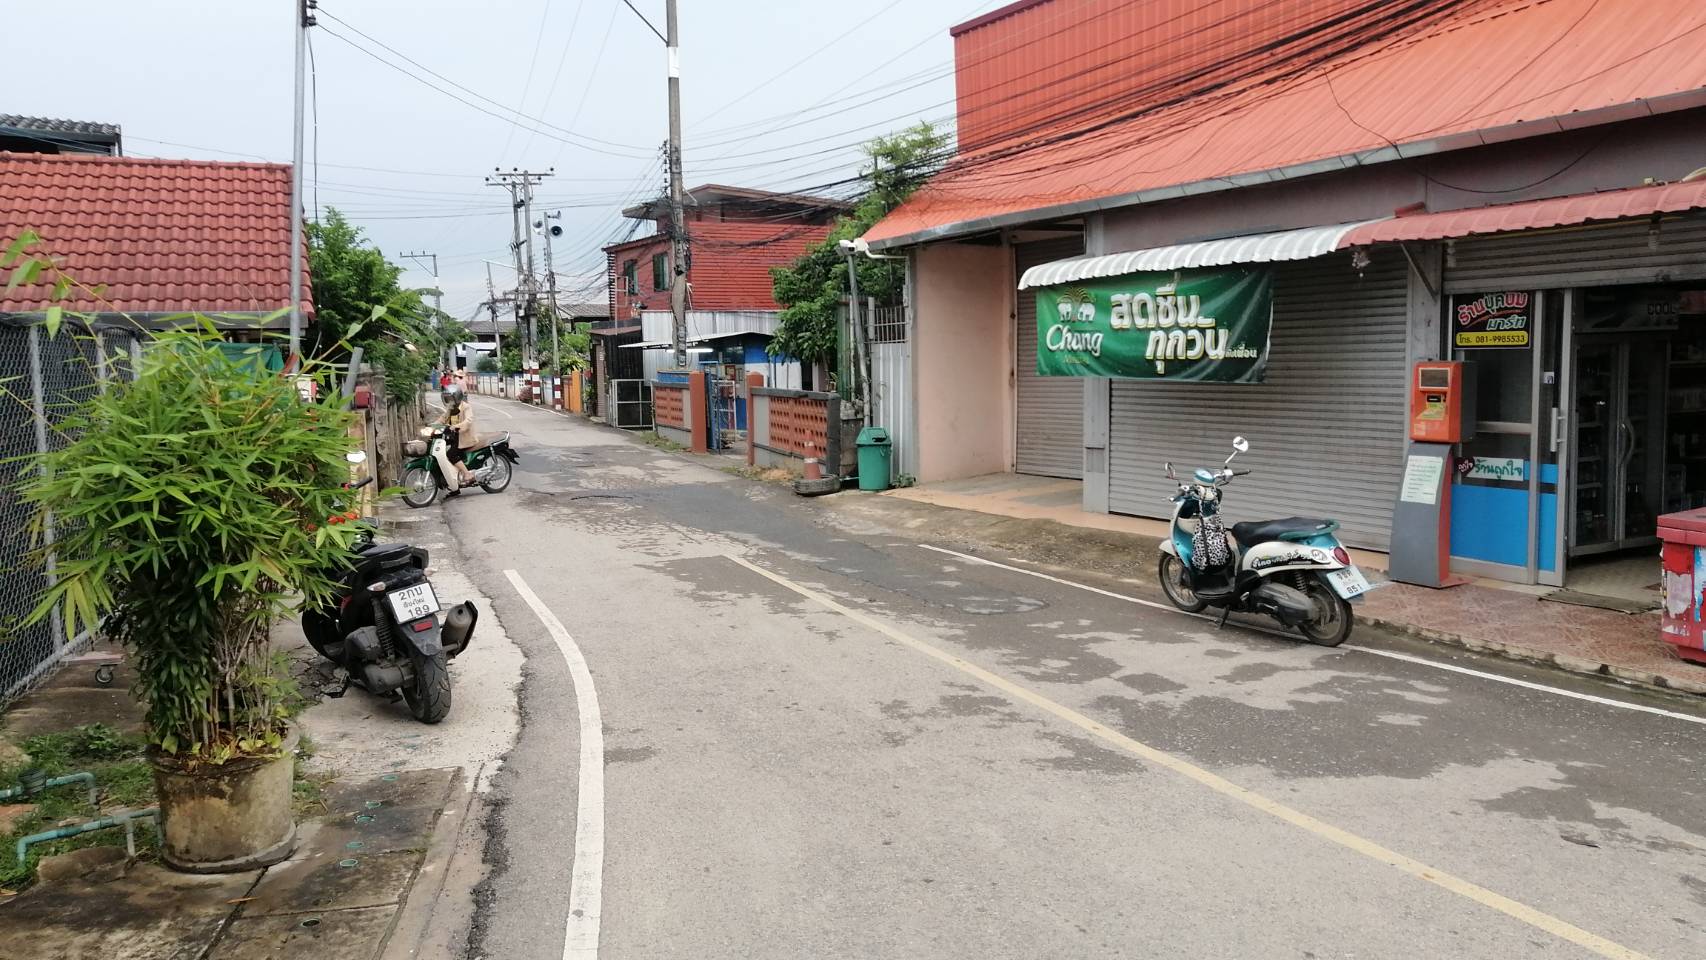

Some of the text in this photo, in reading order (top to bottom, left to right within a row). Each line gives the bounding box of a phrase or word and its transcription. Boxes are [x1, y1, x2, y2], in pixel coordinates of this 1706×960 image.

[1110, 272, 1200, 329] สดชื่น
[1046, 324, 1104, 356] Chang
[1145, 317, 1228, 374] ทุกวัน
[408, 605, 429, 616] 189
